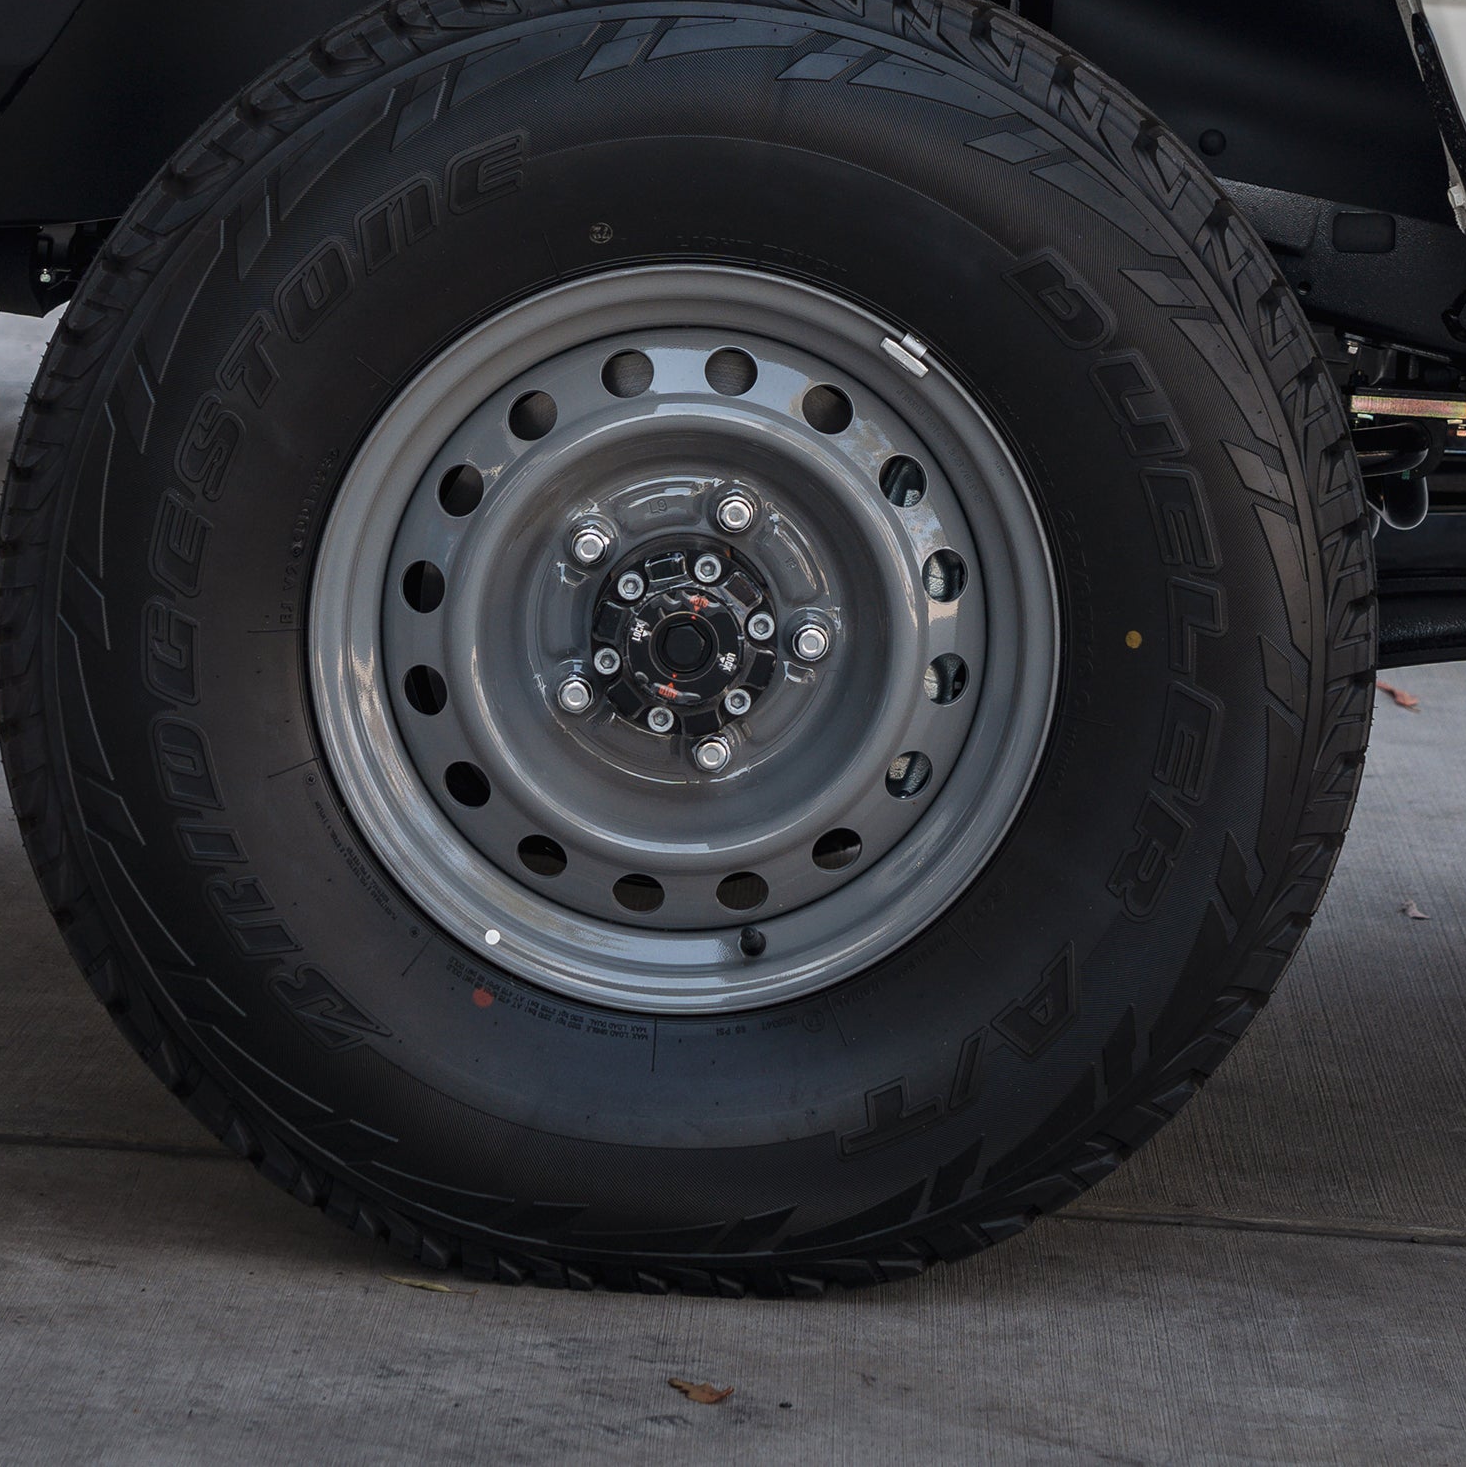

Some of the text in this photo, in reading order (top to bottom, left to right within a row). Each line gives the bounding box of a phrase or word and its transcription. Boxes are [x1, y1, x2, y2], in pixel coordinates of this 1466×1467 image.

[140, 123, 540, 1077] BRIDGESTONE
[631, 621, 645, 642] LOCK
[722, 652, 737, 672] LOCK
[658, 685, 678, 699] AUTO
[824, 226, 1230, 1166] DUELER A/T
